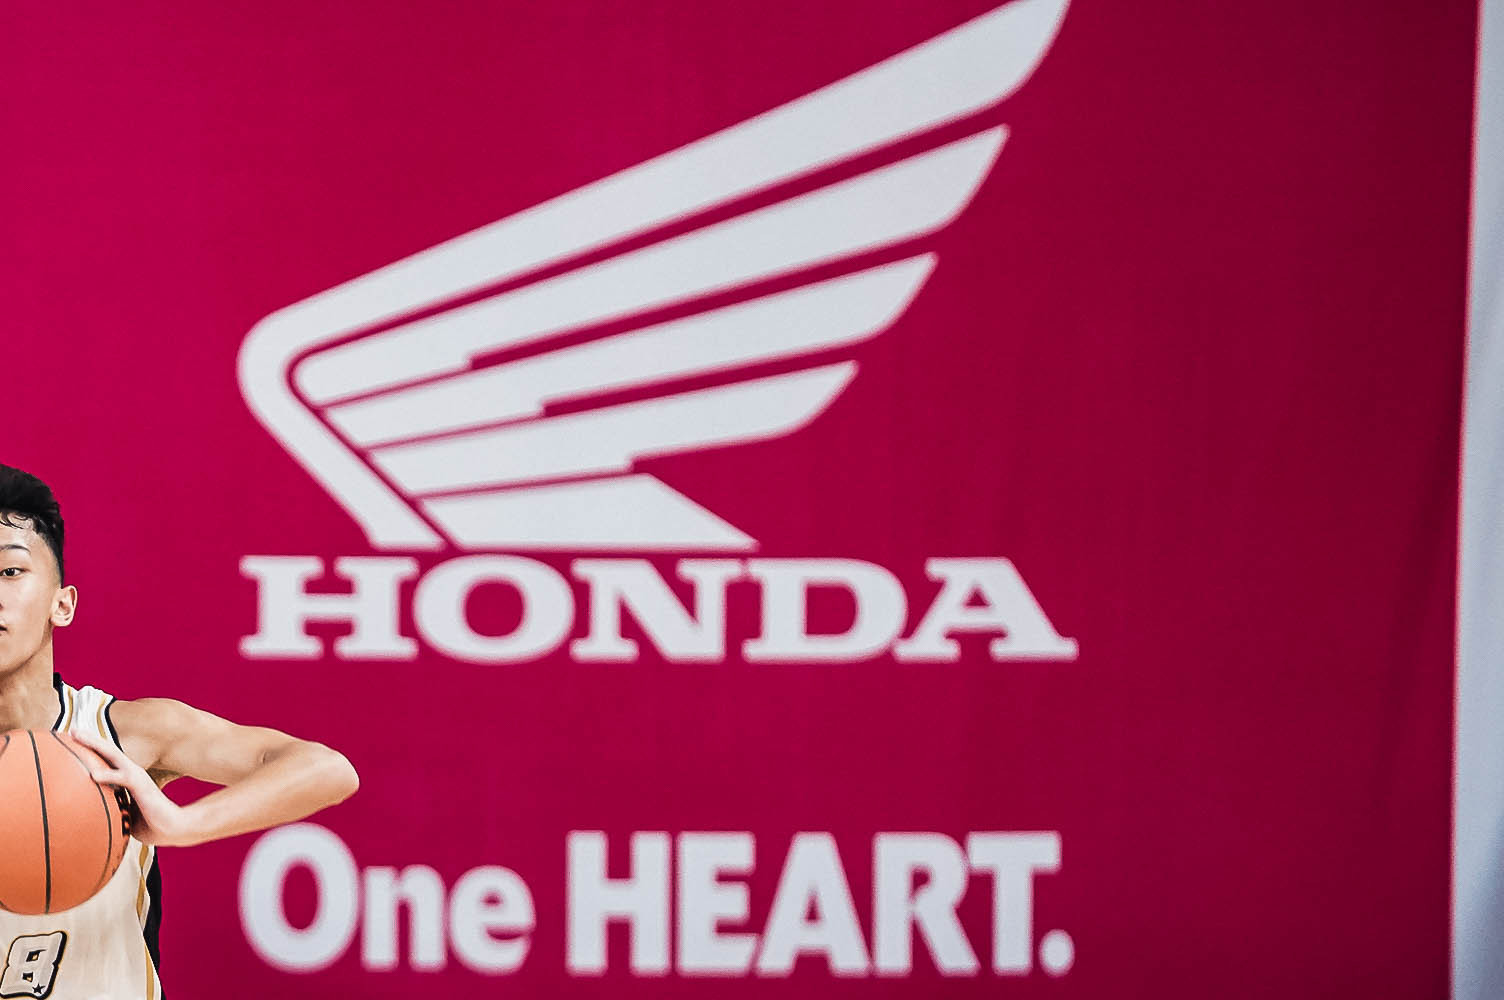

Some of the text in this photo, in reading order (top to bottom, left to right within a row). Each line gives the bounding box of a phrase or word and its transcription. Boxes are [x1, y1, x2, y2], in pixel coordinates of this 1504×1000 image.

[239, 554, 1079, 662] HONDA
[238, 822, 1076, 976] One HEART.
